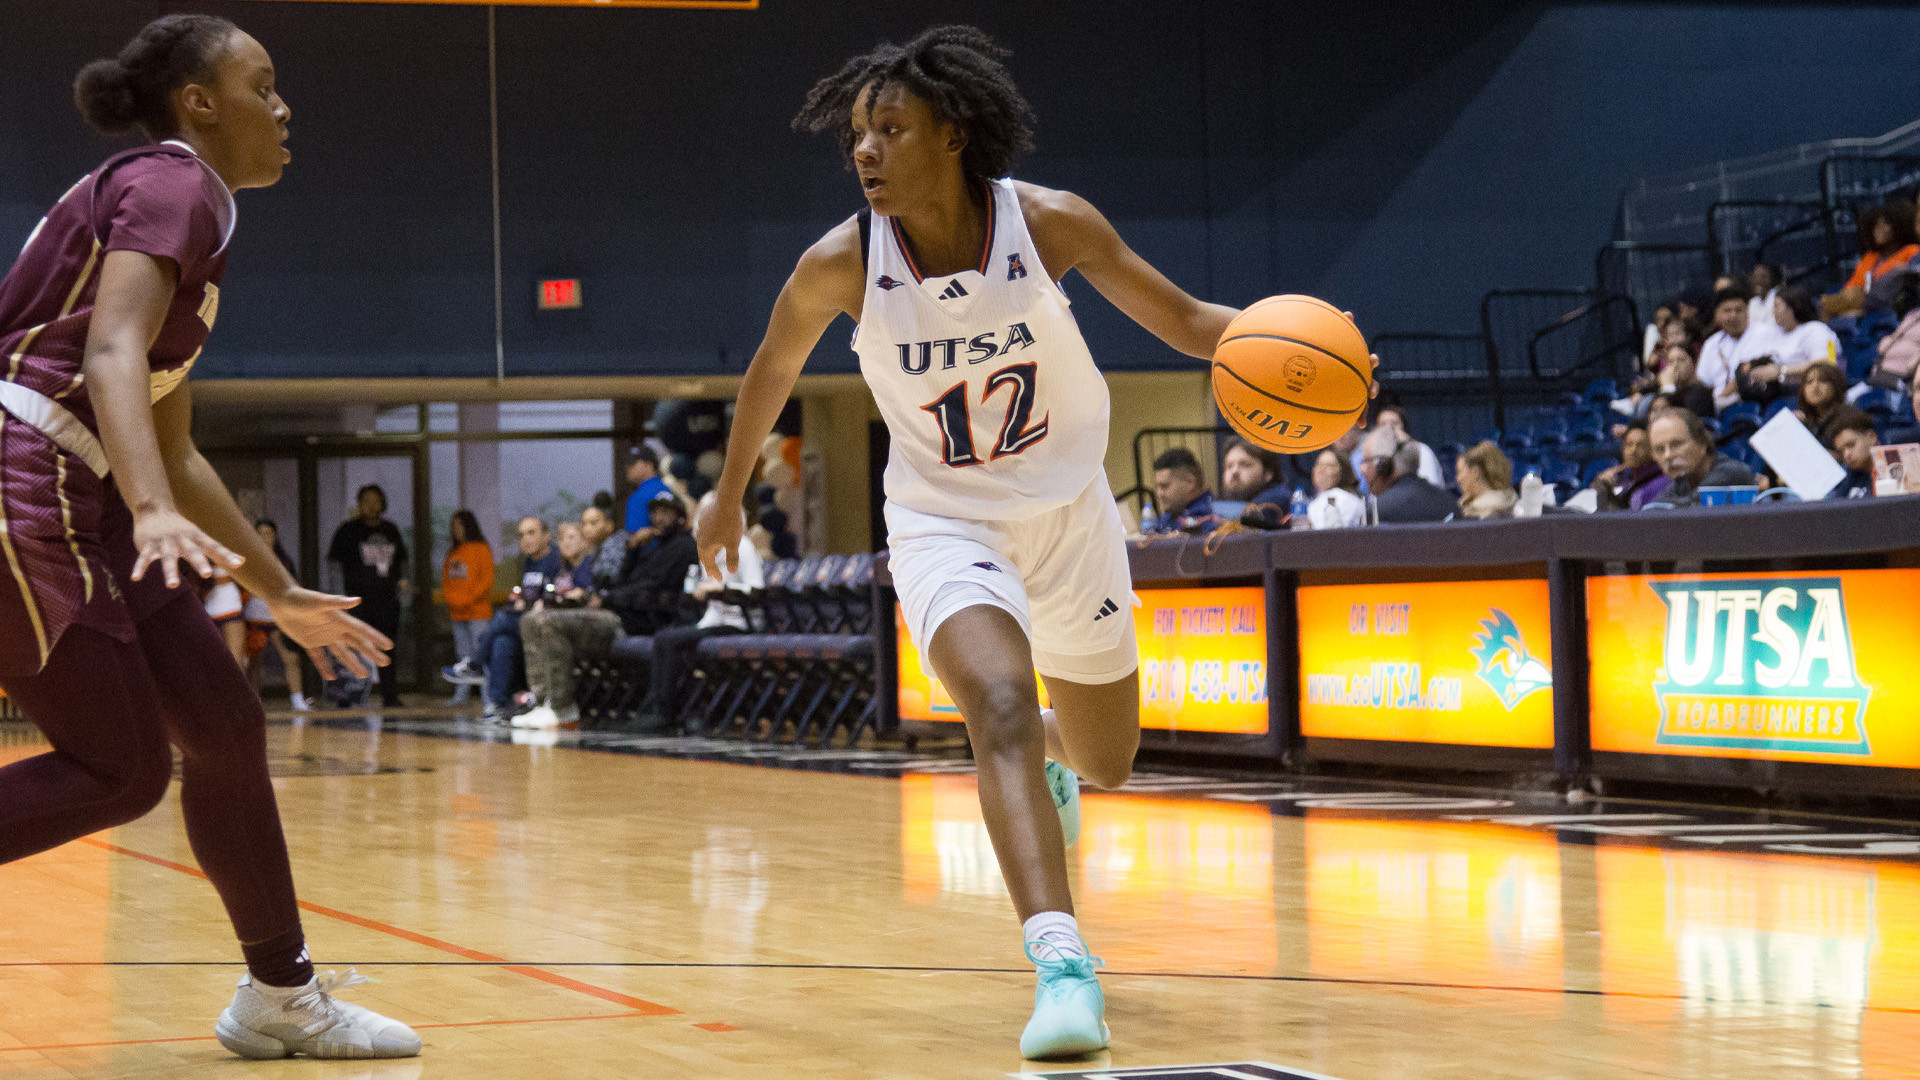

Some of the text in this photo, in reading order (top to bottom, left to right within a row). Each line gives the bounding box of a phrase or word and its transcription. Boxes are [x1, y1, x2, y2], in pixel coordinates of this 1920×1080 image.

[895, 322, 1036, 375] UTSA
[919, 361, 1050, 468] 12
[1246, 409, 1313, 439] EVO
[1154, 605, 1257, 636] FOR TICKETS CALL
[1350, 602, 1411, 635] OR VISIT
[1665, 586, 1856, 688] UTSA
[1677, 701, 1846, 736] ROADRUNNERS
